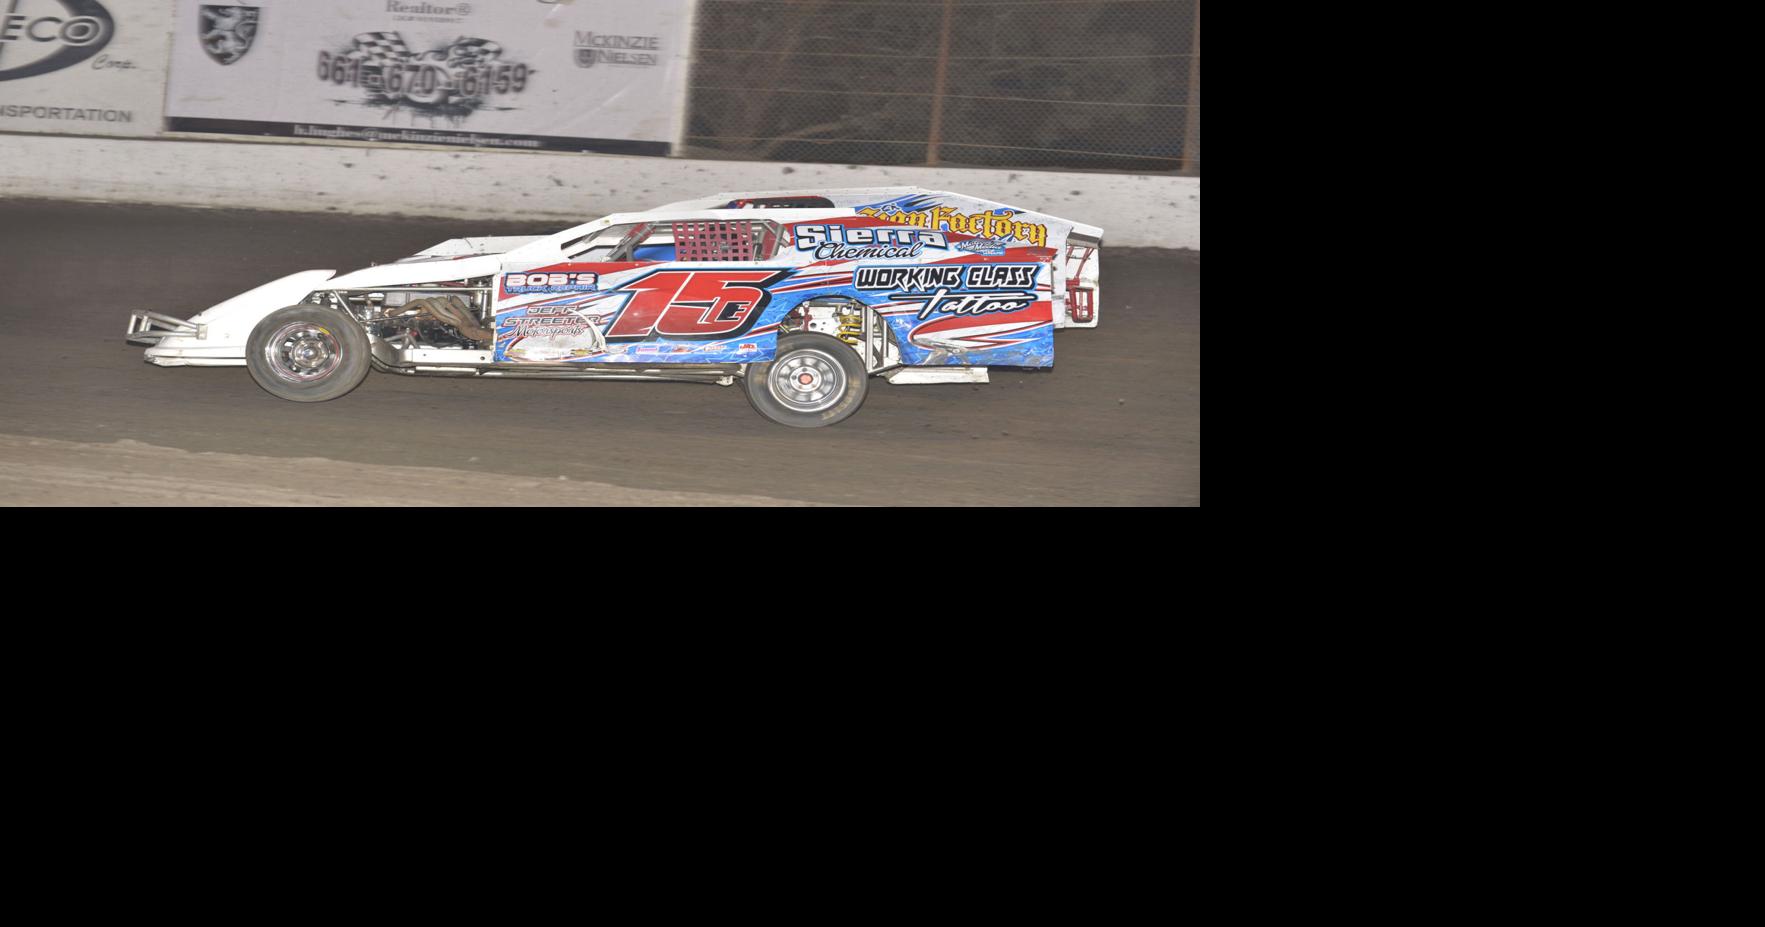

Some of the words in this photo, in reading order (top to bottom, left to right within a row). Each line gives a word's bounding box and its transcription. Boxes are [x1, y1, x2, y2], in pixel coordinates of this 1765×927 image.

[797, 223, 947, 250] Sierra
[930, 207, 1047, 247] Factory
[814, 241, 921, 260] Chemical
[506, 273, 596, 287] BOB'S
[856, 265, 961, 292] WORKING
[966, 266, 1037, 290] CLASS
[527, 305, 578, 315] JEFF
[605, 270, 782, 338] 15
[891, 290, 1036, 319] Tattoo
[503, 316, 602, 328] STREETER
